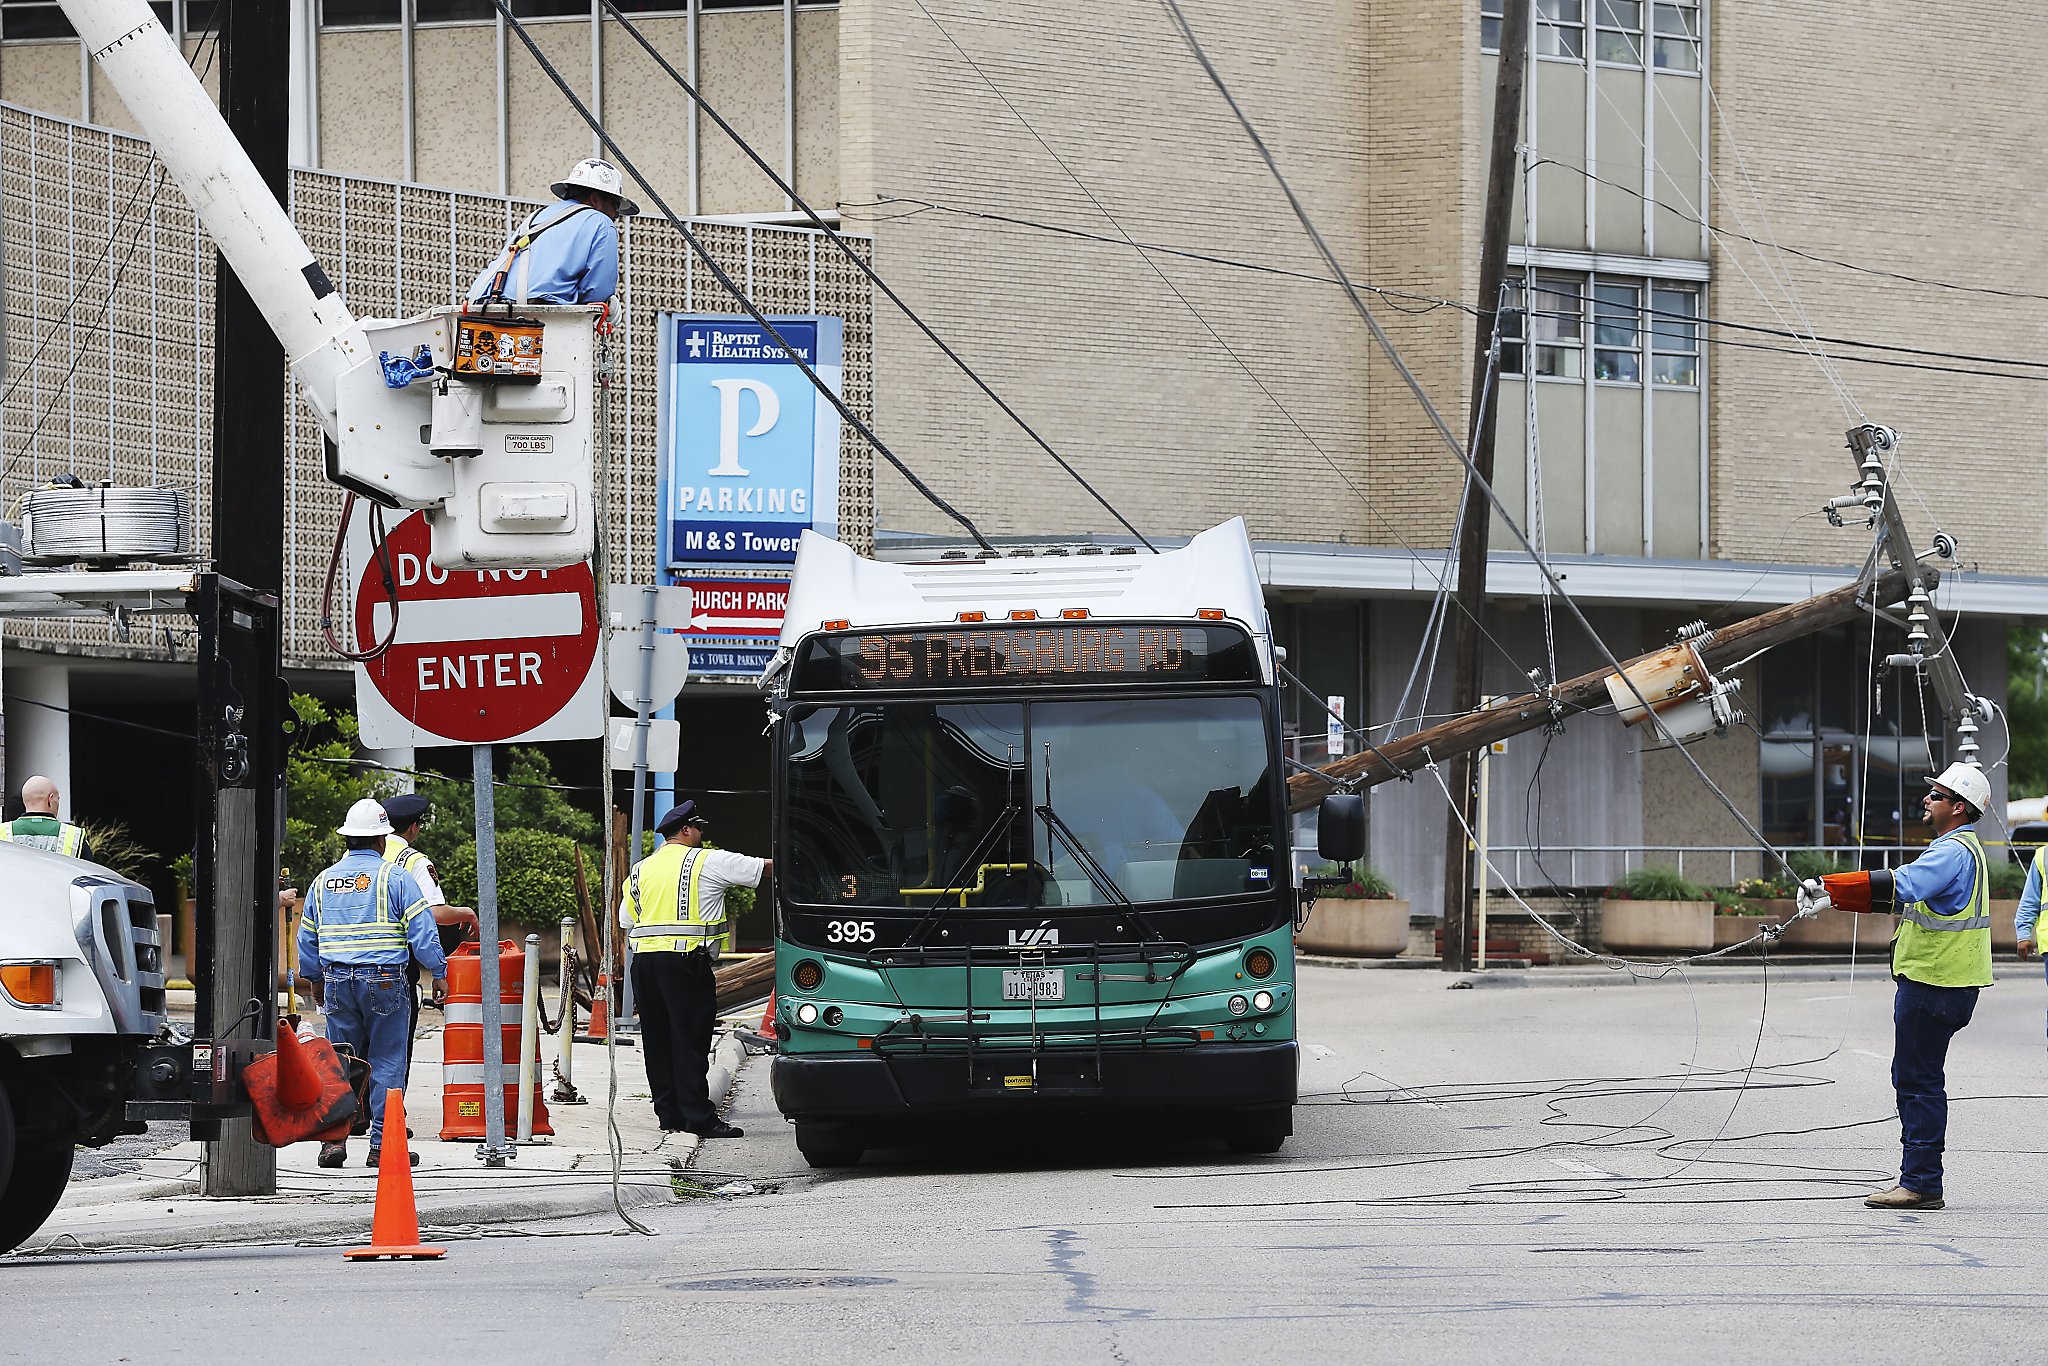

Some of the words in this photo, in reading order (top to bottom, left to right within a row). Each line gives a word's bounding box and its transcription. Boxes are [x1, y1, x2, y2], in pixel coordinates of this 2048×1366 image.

[712, 331, 761, 345] BAPTIST
[711, 344, 760, 358] HEALTH
[708, 378, 780, 477] P
[512, 441, 528, 449] 700
[530, 441, 546, 449] LBS
[680, 487, 806, 514] PARKING
[685, 531, 703, 550] M
[706, 531, 721, 551] &
[724, 531, 736, 551] S
[742, 531, 800, 552] Tower
[398, 553, 449, 587] DO
[692, 591, 742, 610] HURCH
[747, 592, 788, 611] PARK
[700, 654, 705, 665] S
[708, 654, 735, 666] TOWER
[860, 634, 913, 679] 95
[926, 627, 1124, 678] FREDSBURG
[1139, 628, 1182, 671] RD
[418, 652, 543, 691] ENTER
[326, 878, 355, 892] cps
[681, 858, 692, 916] SUPERVISOR
[842, 874, 857, 898] 3
[827, 920, 876, 943] 395
